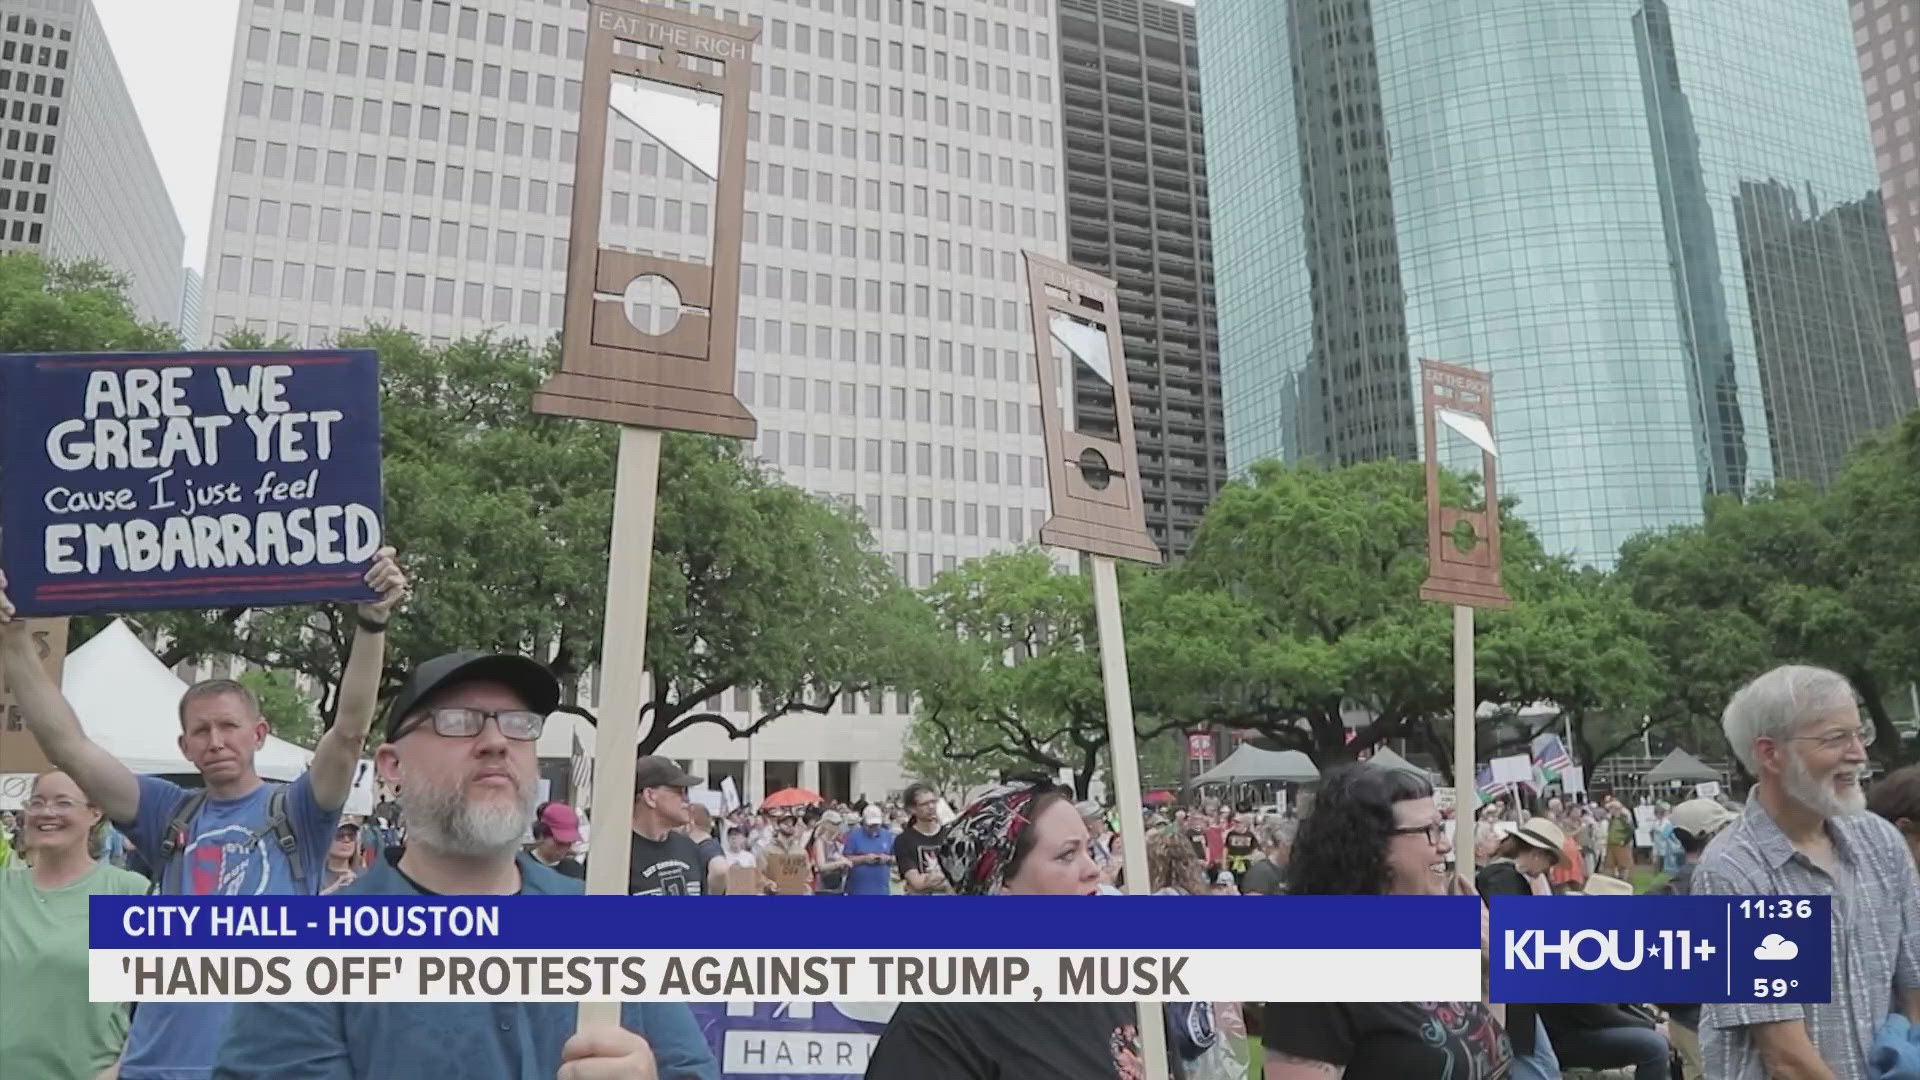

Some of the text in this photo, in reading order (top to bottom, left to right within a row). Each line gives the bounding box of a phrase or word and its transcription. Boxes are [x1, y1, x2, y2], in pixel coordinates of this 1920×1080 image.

[599, 12, 745, 60] EAT THE RICH
[85, 365, 293, 419] ARE WE
[1425, 369, 1489, 393] EAT THE RICH
[46, 410, 343, 471] GREAT YET
[44, 468, 320, 516] Cause I just feel
[44, 503, 382, 574] EMBARRASED
[743, 1039, 873, 1065] HARRI
